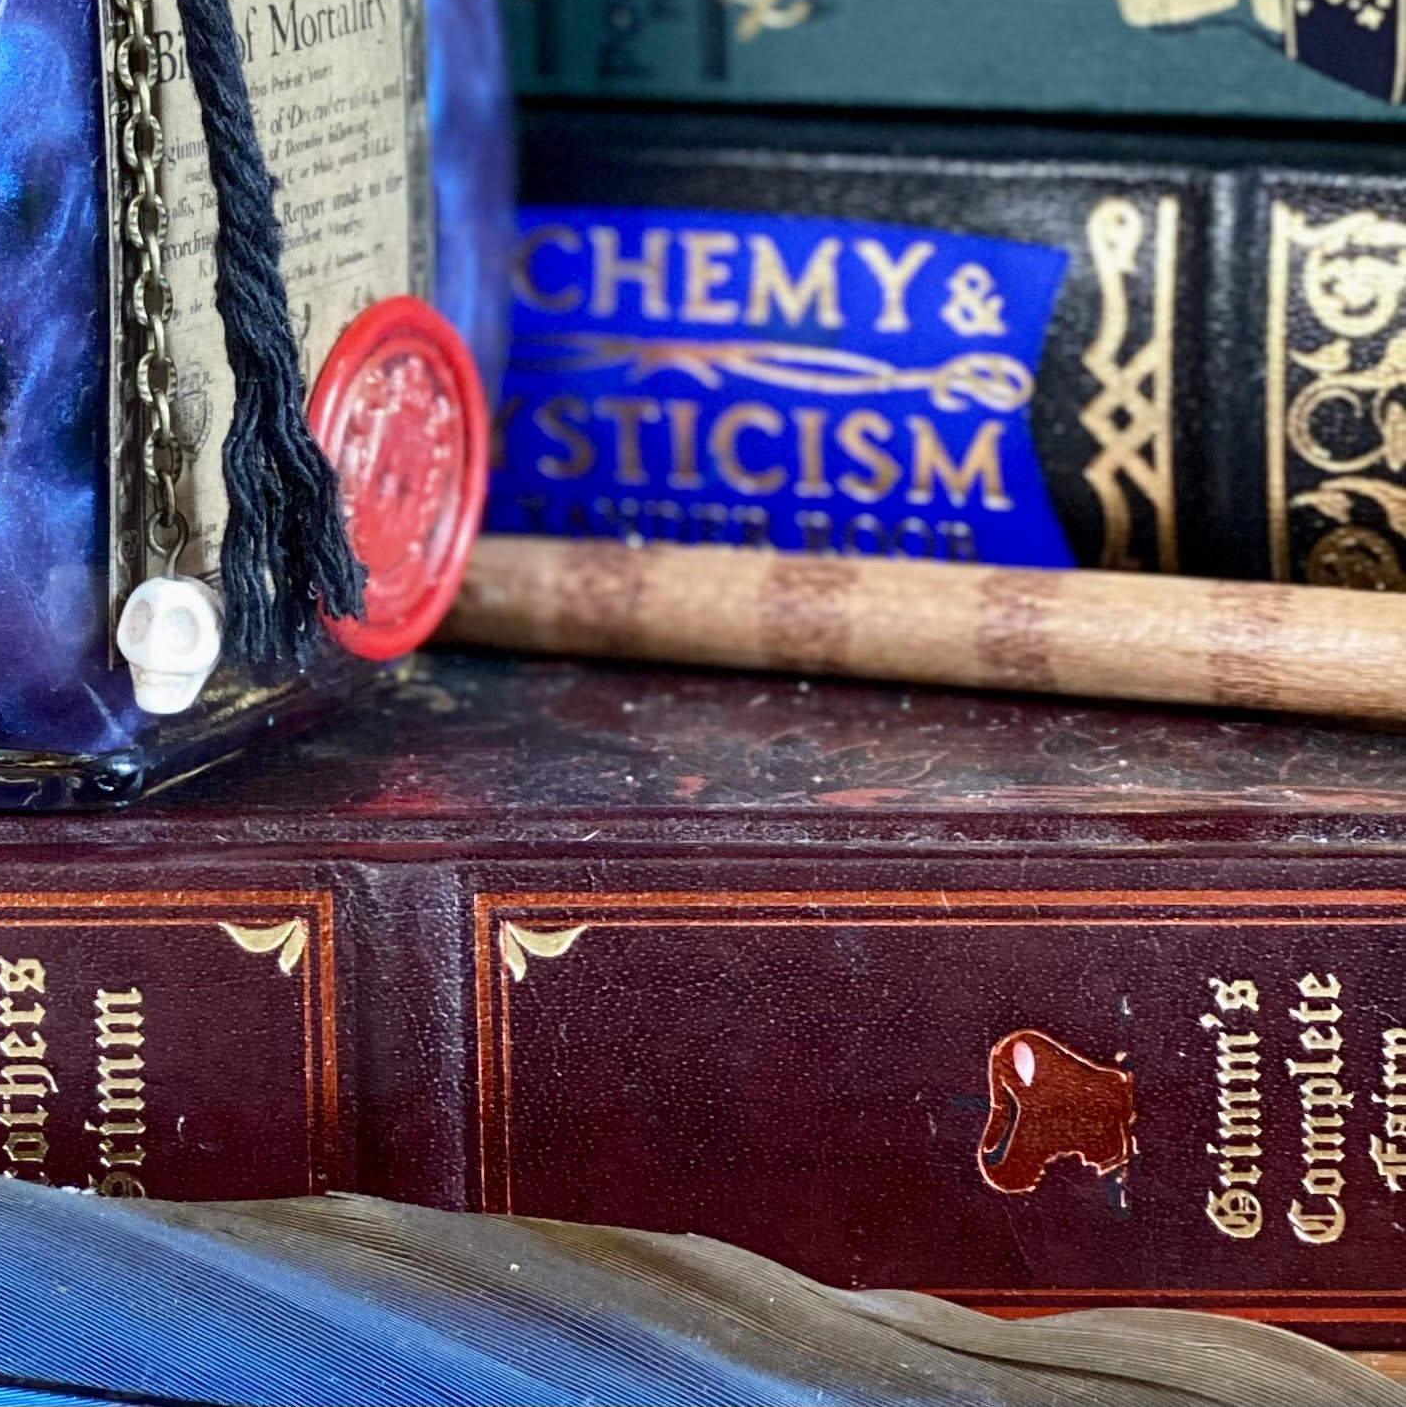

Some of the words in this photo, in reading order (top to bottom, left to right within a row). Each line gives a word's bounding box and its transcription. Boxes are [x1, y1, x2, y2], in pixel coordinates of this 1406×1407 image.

[941, 260, 1008, 338] &
[1199, 976, 1263, 1240] Grimm's
[1285, 971, 1356, 1245] Complete
